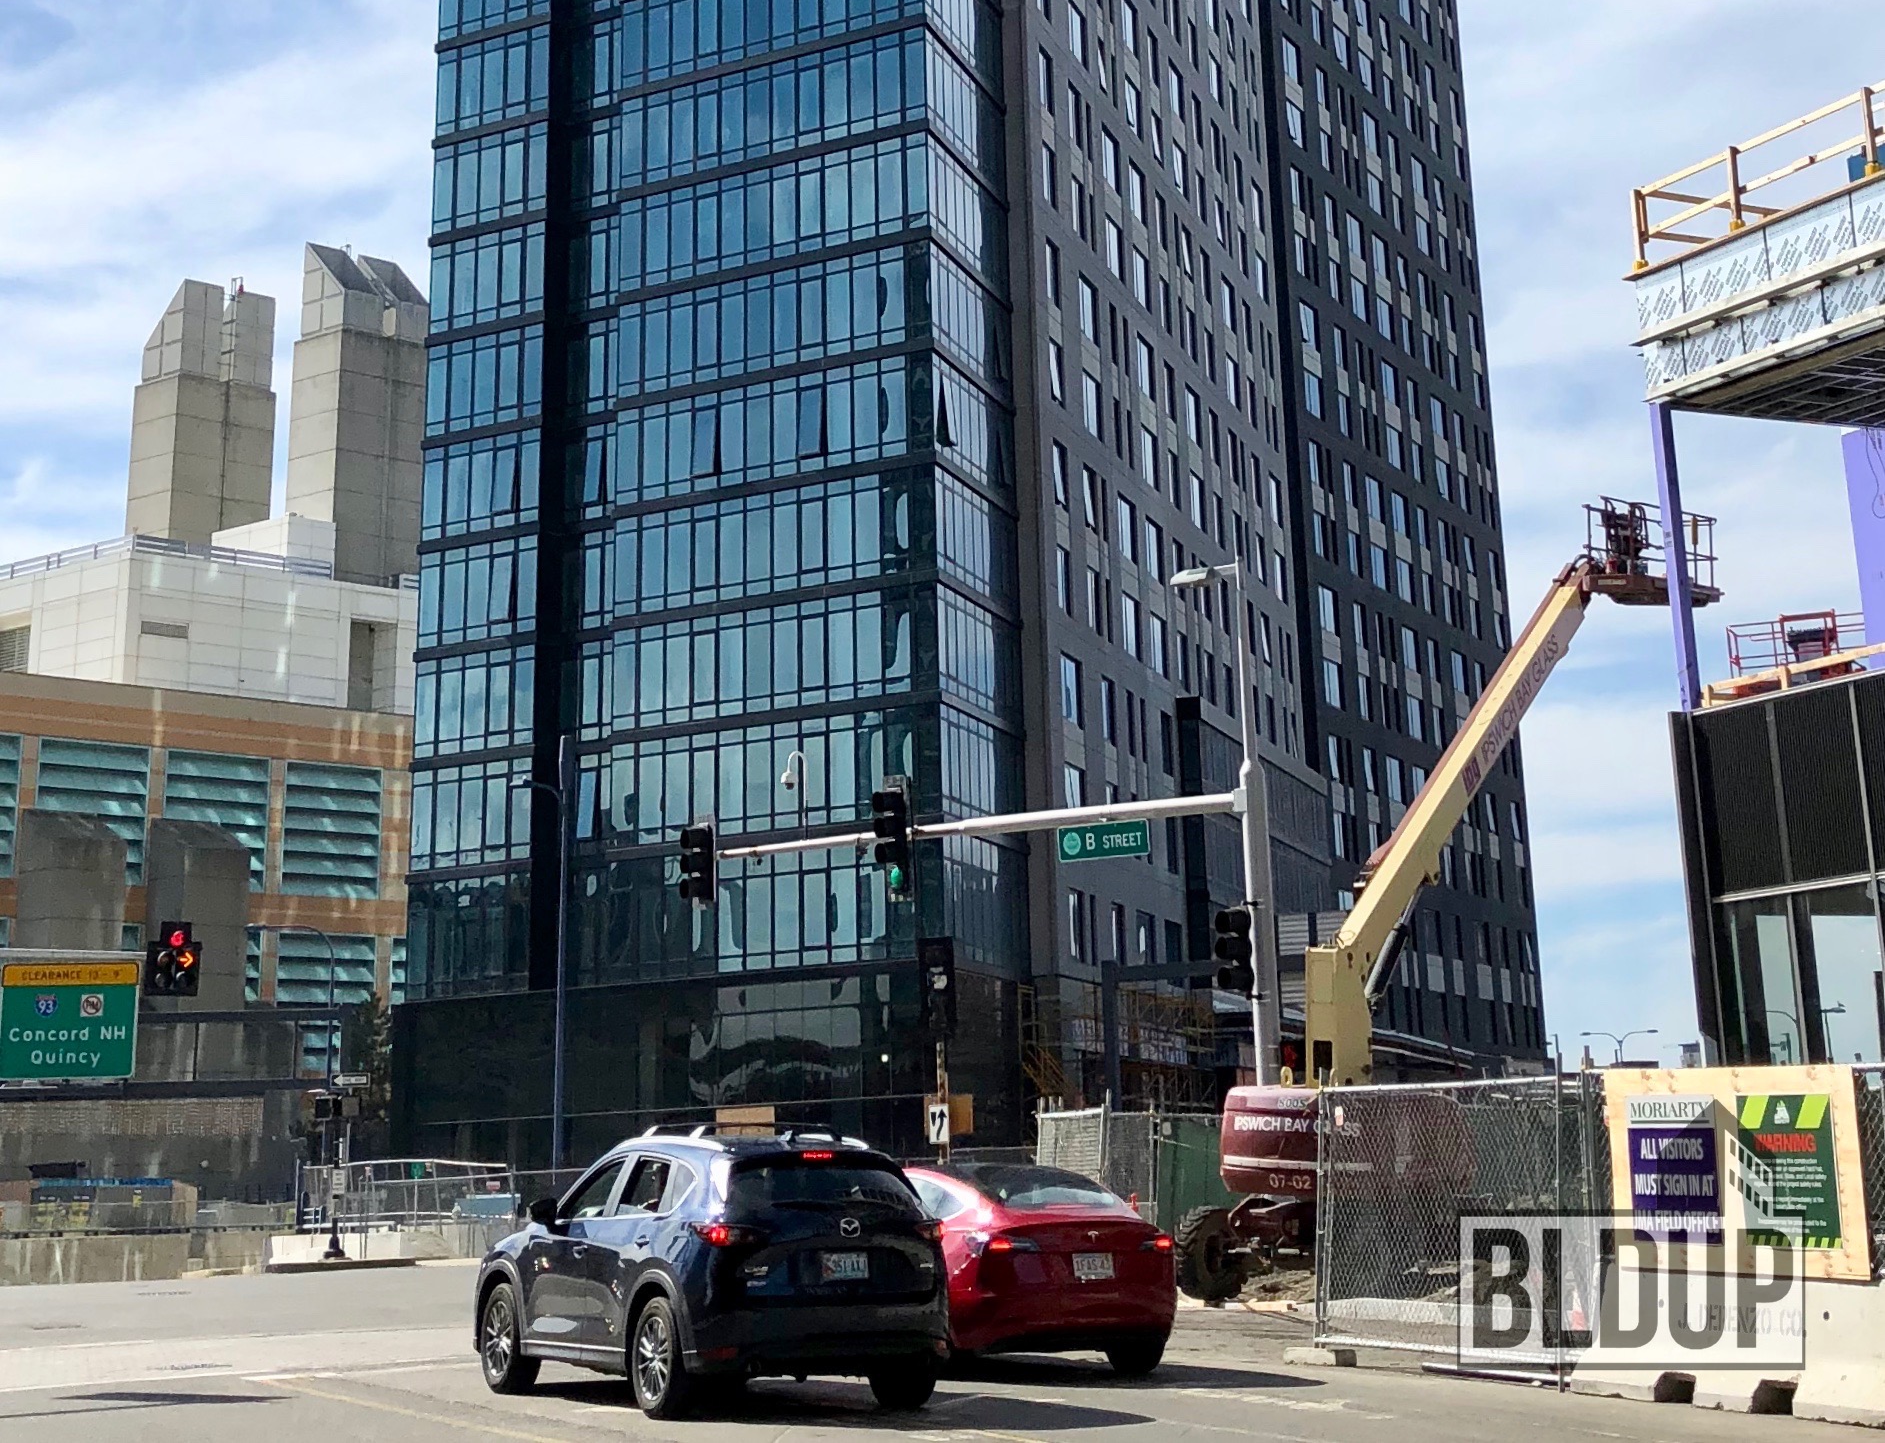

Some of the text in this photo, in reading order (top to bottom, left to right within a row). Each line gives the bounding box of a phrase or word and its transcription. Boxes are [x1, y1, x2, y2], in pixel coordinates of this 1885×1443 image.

[1481, 699, 1518, 765] IPSWICH
[1515, 672, 1532, 710] BAY
[1532, 633, 1559, 683] GLASS
[1085, 832, 1142, 850] B STREET
[21, 969, 82, 981] CLEARANCE
[38, 1000, 54, 1014] 93
[8, 1025, 126, 1042] Concord NH
[30, 1048, 101, 1068] Quincy
[1630, 1101, 1709, 1118] MORIARTY
[1284, 1117, 1310, 1133] BAY
[1640, 1138, 1704, 1160] ALL VISITORS
[1754, 1133, 1817, 1152] WARNING
[1634, 1174, 1714, 1197] MUST SIGN IN AT
[1655, 1209, 1682, 1233] FIELD
[1683, 1210, 1719, 1234] OFFICE
